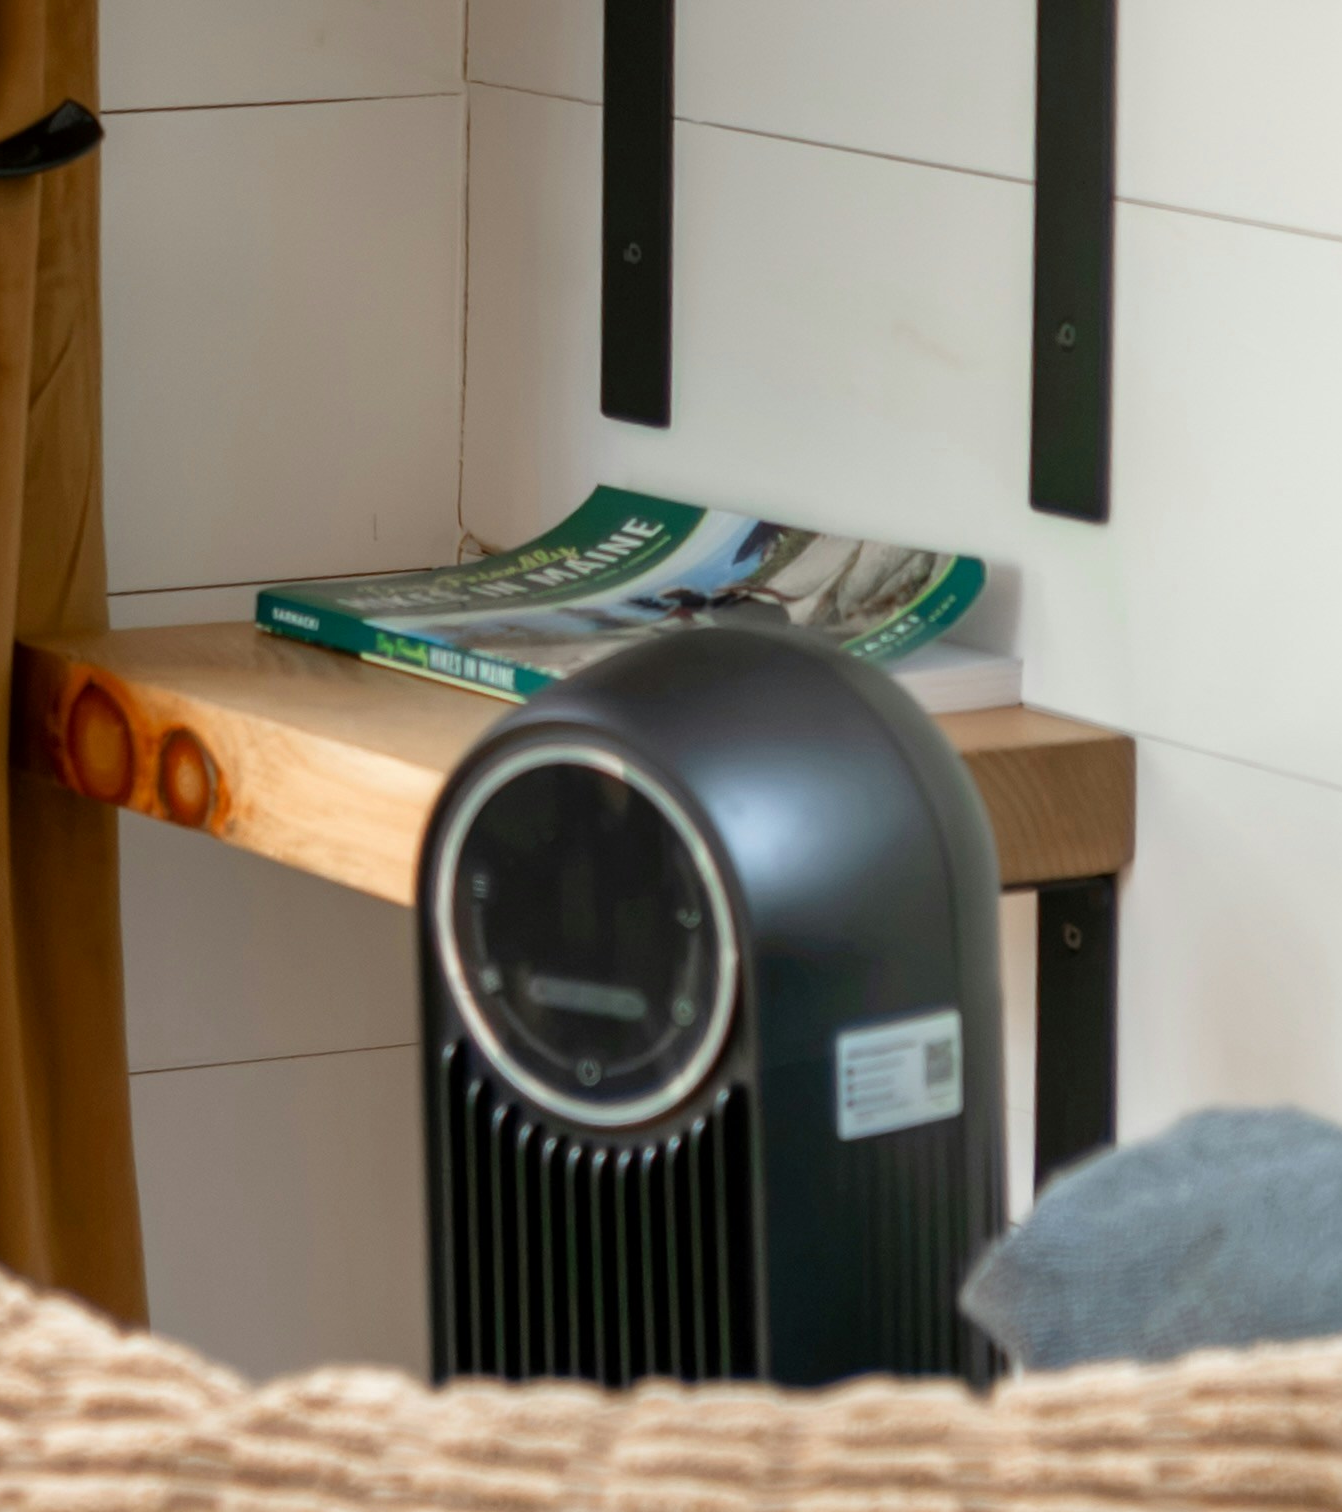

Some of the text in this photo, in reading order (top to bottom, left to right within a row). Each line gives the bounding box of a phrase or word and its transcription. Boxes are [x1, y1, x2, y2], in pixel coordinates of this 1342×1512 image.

[468, 580, 529, 598] IN
[523, 517, 665, 587] MAINE
[428, 645, 462, 677] HIKES
[463, 655, 477, 679] IN
[478, 658, 516, 693] MAINE
